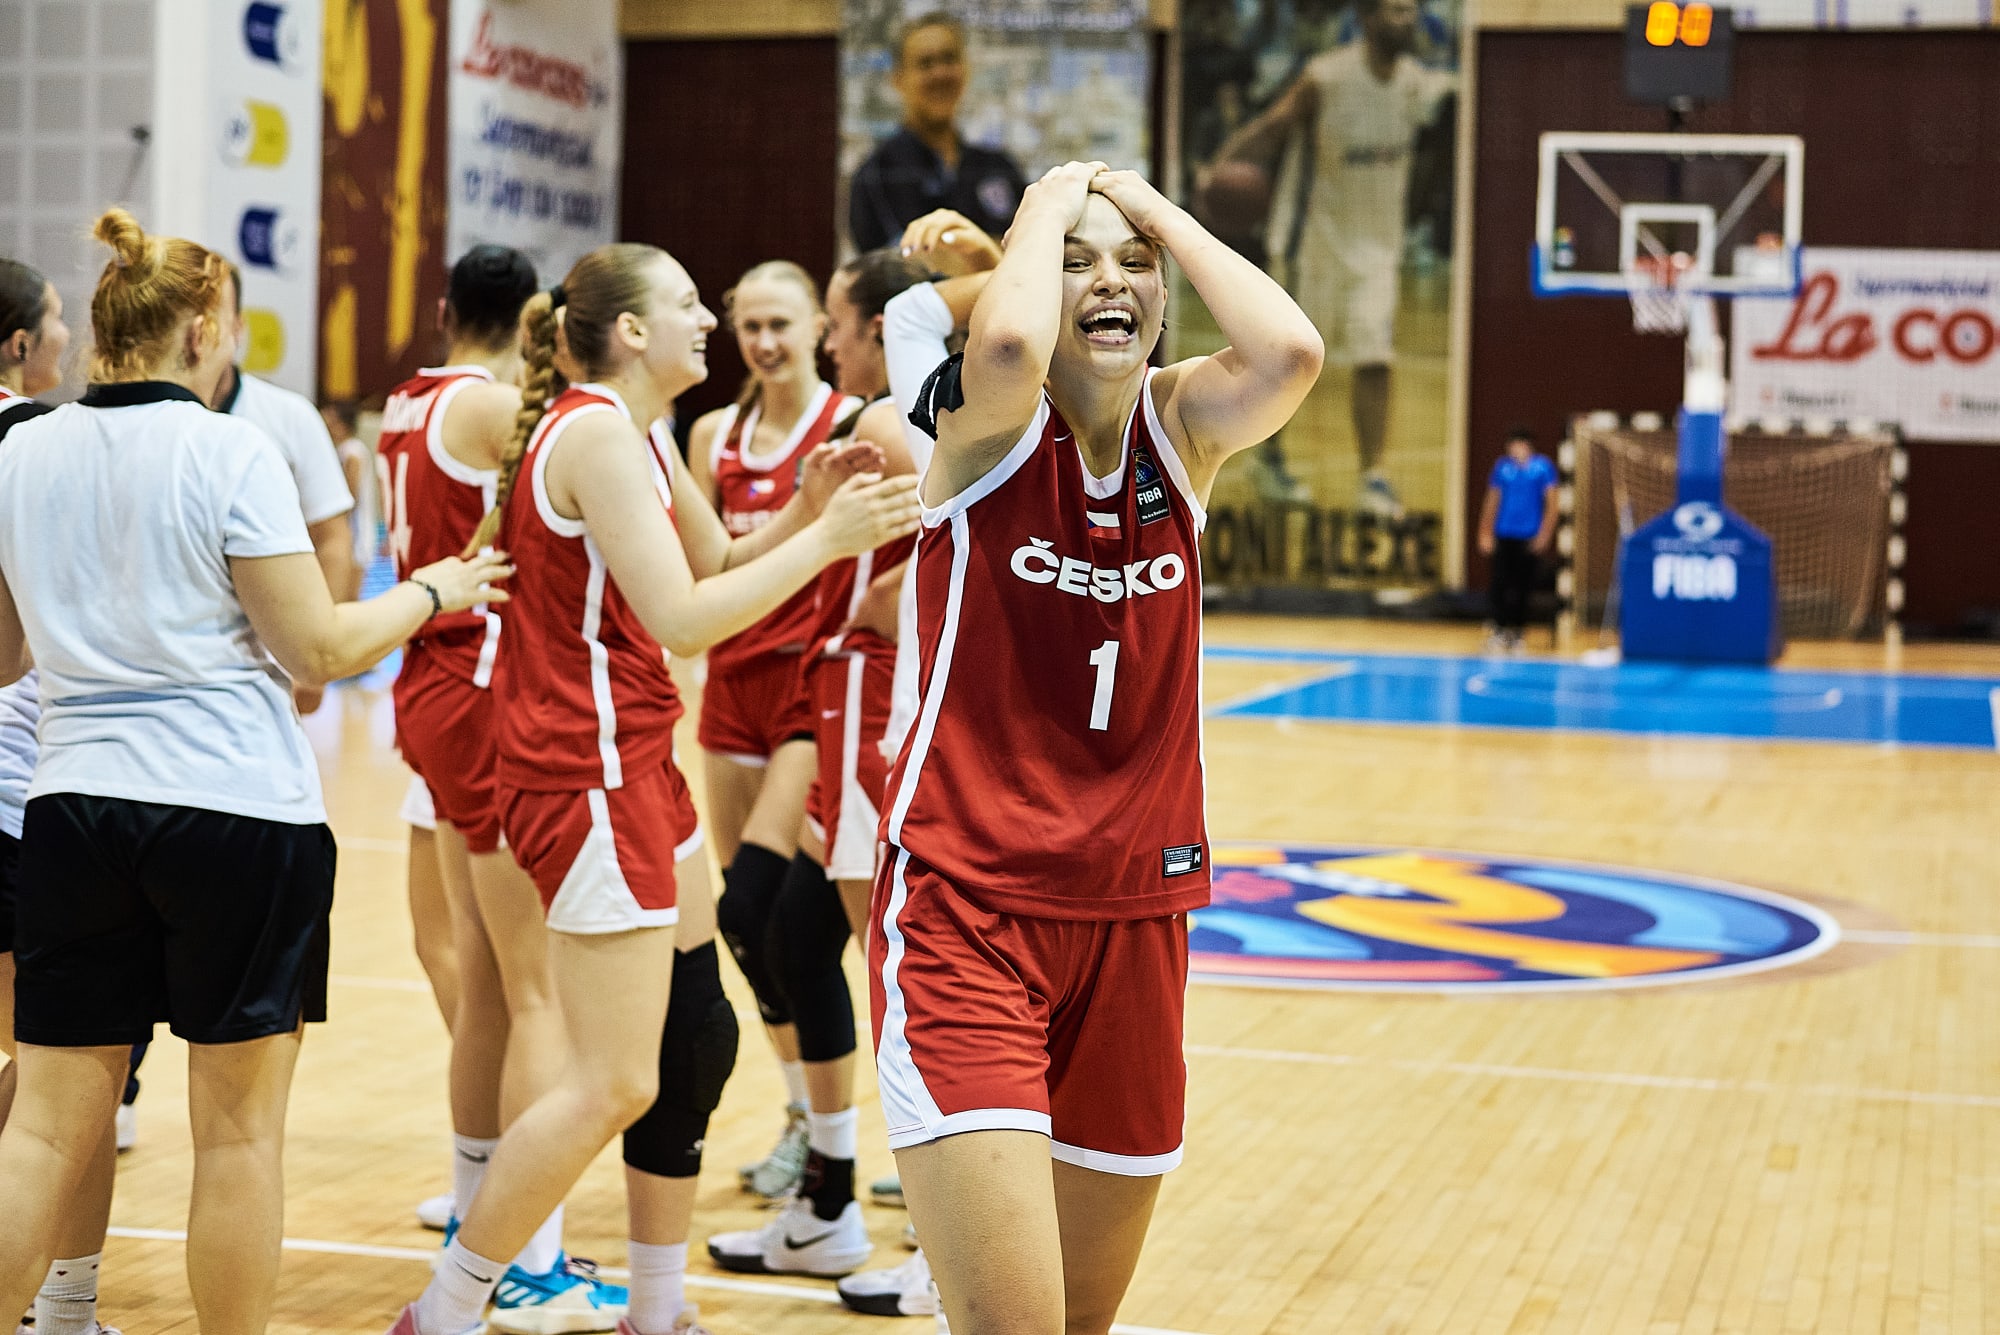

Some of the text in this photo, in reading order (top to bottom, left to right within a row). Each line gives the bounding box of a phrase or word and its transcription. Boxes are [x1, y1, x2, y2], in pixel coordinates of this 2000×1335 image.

[1750, 268, 1878, 363] La
[1137, 487, 1162, 505] FIBA
[1009, 536, 1186, 603] ČESKO
[1088, 639, 1120, 732] 1
